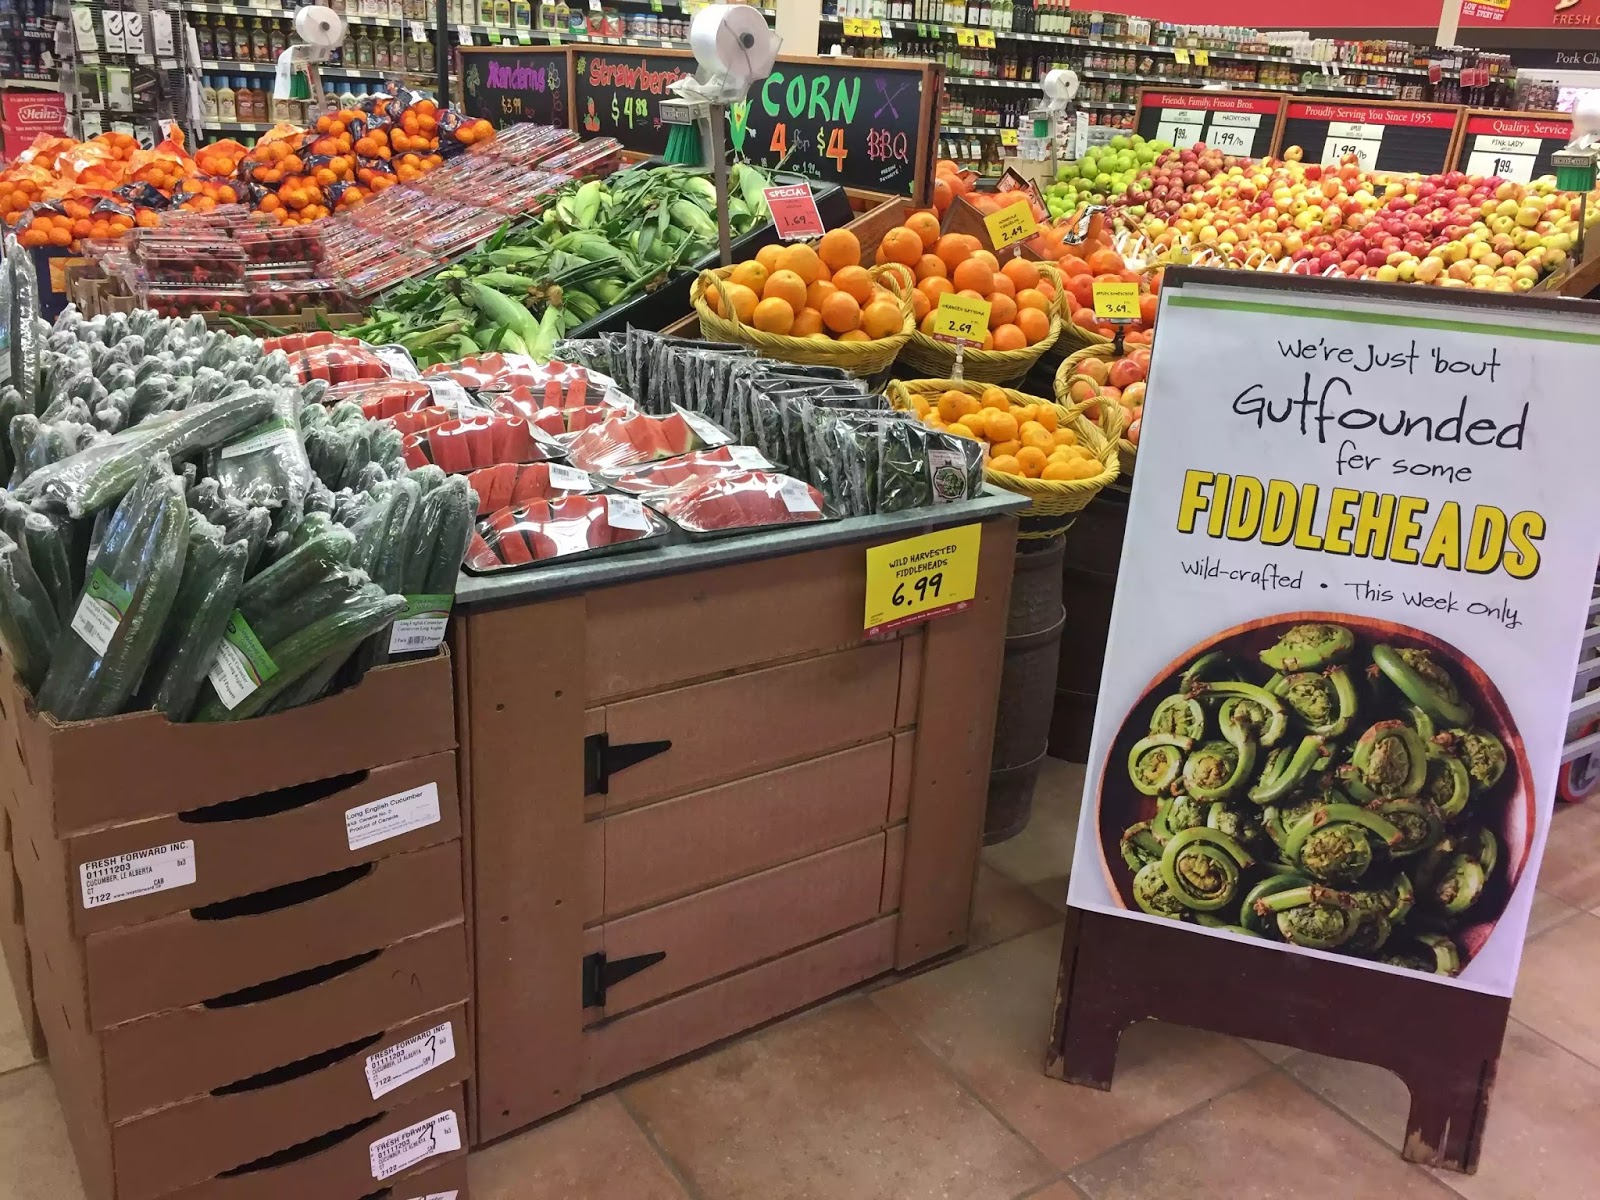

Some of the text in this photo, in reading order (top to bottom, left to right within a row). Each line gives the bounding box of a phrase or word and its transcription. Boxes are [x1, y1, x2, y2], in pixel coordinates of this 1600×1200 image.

[1552, 14, 1591, 25] FRESH
[1555, 52, 1580, 64] Pork
[761, 72, 861, 124] CORN
[1161, 95, 1186, 106] Friends,
[1213, 98, 1235, 108] Freson
[1236, 100, 1254, 110] Bros.
[21, 108, 59, 120] Heinz
[1304, 106, 1434, 124] Proudly Serving You Since 1955.
[1493, 120, 1530, 136] Quality,
[1532, 122, 1569, 136] Service
[769, 122, 788, 165] 4
[866, 128, 909, 164] BBQ
[768, 188, 807, 198] SPECIAL
[784, 216, 806, 226] 1.69
[1002, 226, 1023, 242] 2.49
[1106, 304, 1126, 313] 3.69
[948, 320, 972, 334] 2.69
[1232, 372, 1530, 451] Gutfounded
[1335, 439, 1472, 484] fer some
[1176, 469, 1547, 580] FIDDLEHEADS
[889, 544, 958, 568] WILD HARVESTED
[896, 558, 948, 579] FIDDLEHEADS
[891, 572, 944, 607] 6.99
[1344, 580, 1394, 602] This
[346, 792, 422, 820] Long English Cucumber
[349, 824, 370, 834] Product
[378, 814, 398, 824] Canada
[85, 841, 189, 870] FRESH FORWARD INC.
[86, 862, 131, 880] 01111203
[86, 866, 153, 888] CUCUMBER, LE ALBERTA
[88, 892, 112, 904] 7122
[370, 1024, 448, 1062] FRESH FORWARD INC.
[372, 1049, 405, 1069] 01111203
[375, 1076, 392, 1088] 7122
[376, 1136, 400, 1152] FRESH
[402, 1120, 436, 1140] FORWARD
[378, 1139, 410, 1158] 01111203
[381, 1164, 397, 1177] 7122
